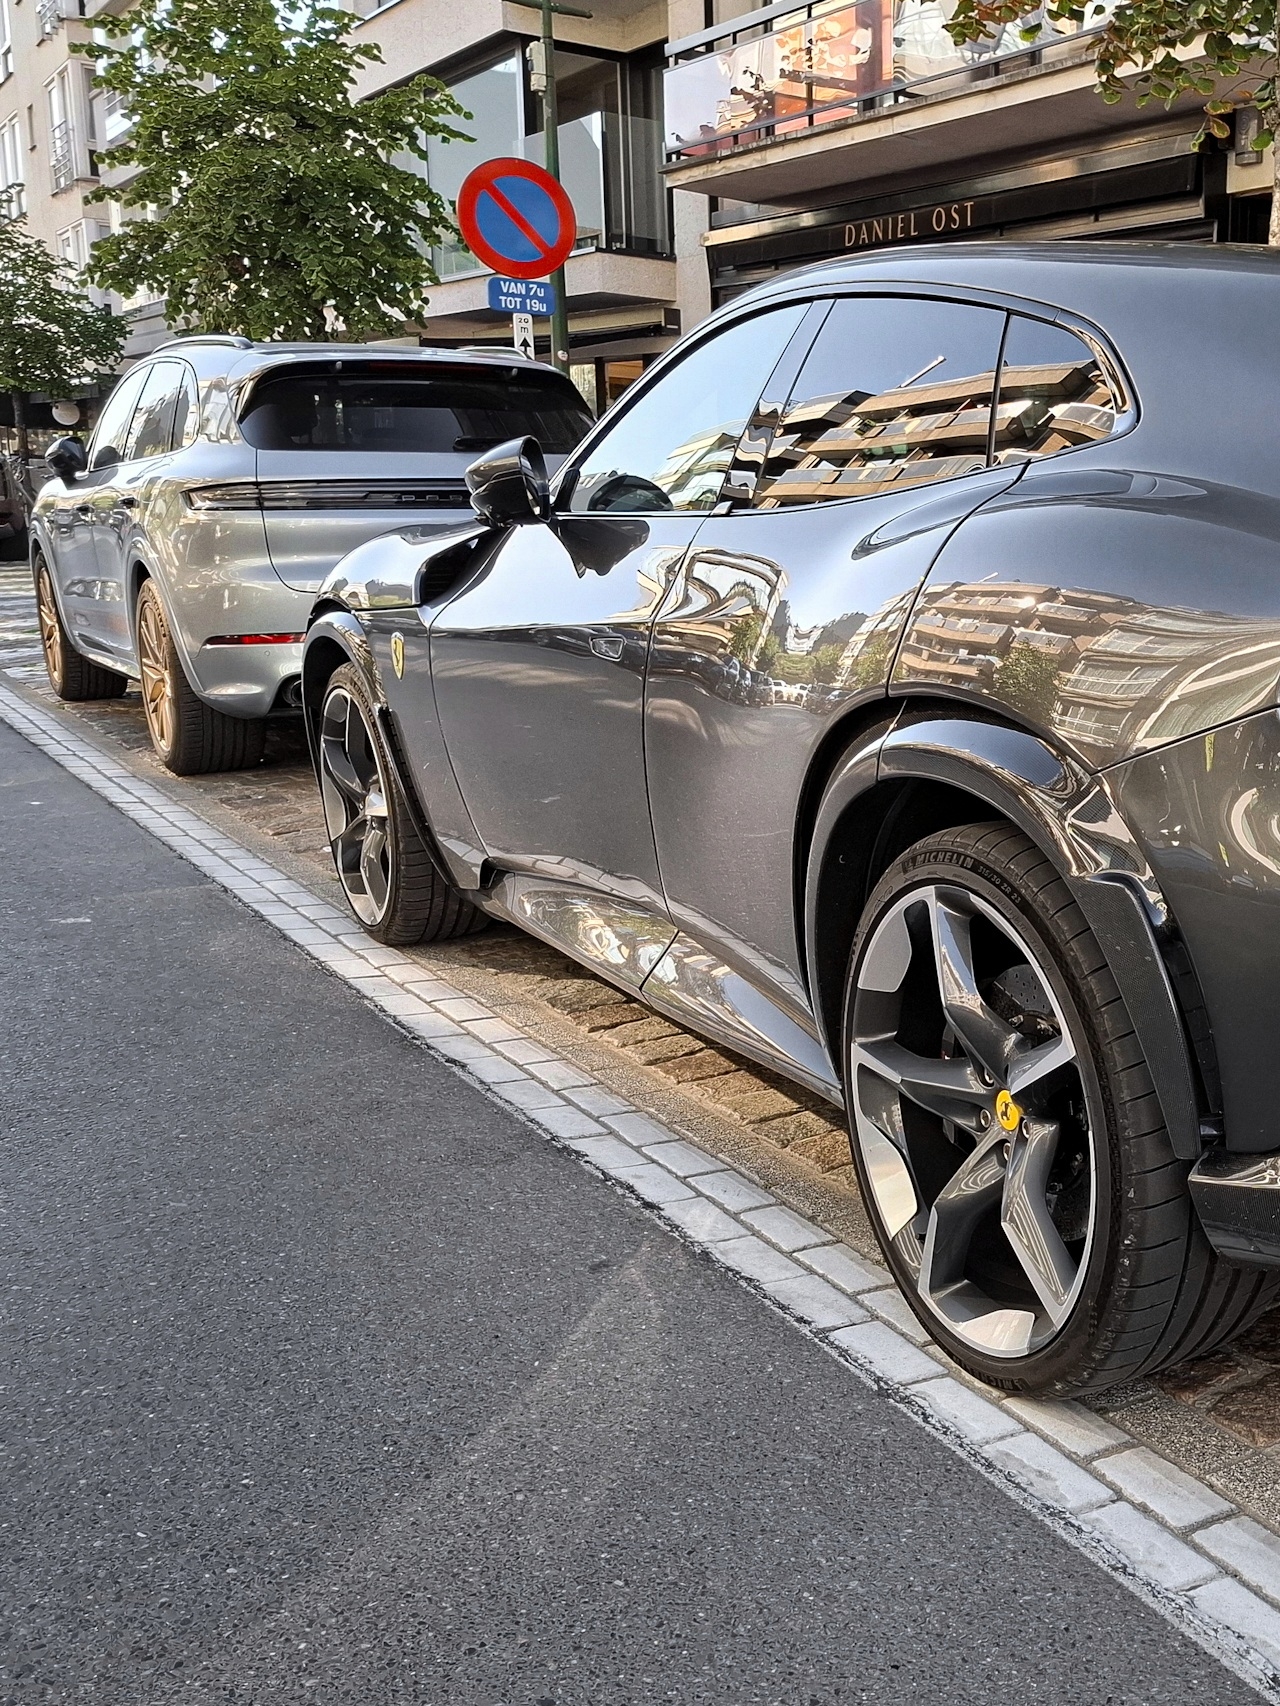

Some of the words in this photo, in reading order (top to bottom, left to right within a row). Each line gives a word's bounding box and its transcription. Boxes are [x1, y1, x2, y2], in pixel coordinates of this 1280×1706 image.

[845, 213, 918, 246] DANIEL
[932, 202, 974, 231] OST
[500, 281, 526, 295] VAN
[529, 284, 545, 297] 7u
[499, 296, 522, 309] TOT
[526, 299, 547, 312] 19u
[520, 326, 529, 334] m
[916, 851, 975, 868] MICHELIN
[978, 865, 1001, 885] 315/30
[1000, 882, 1012, 894] ZR
[1011, 892, 1021, 904] 23
